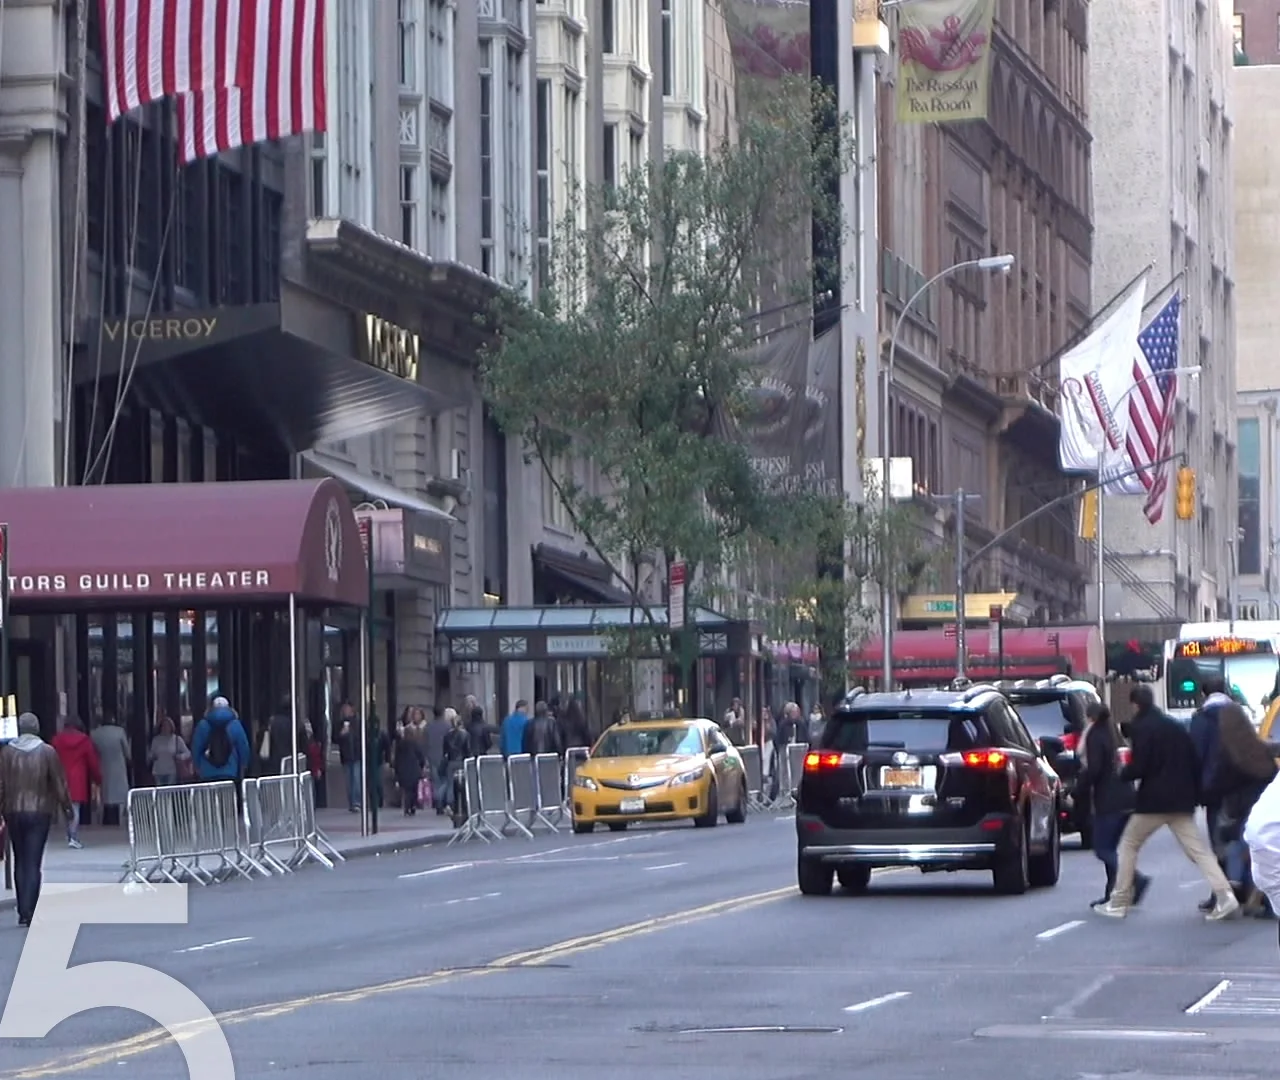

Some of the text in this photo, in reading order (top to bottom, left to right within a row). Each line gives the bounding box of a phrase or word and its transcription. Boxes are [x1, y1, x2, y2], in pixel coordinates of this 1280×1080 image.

[905, 77, 979, 93] The Russian
[910, 98, 972, 113] Tea Room
[79, 573, 151, 590] GUILD
[163, 569, 270, 589] THEATER
[1183, 640, 1201, 657] M31
